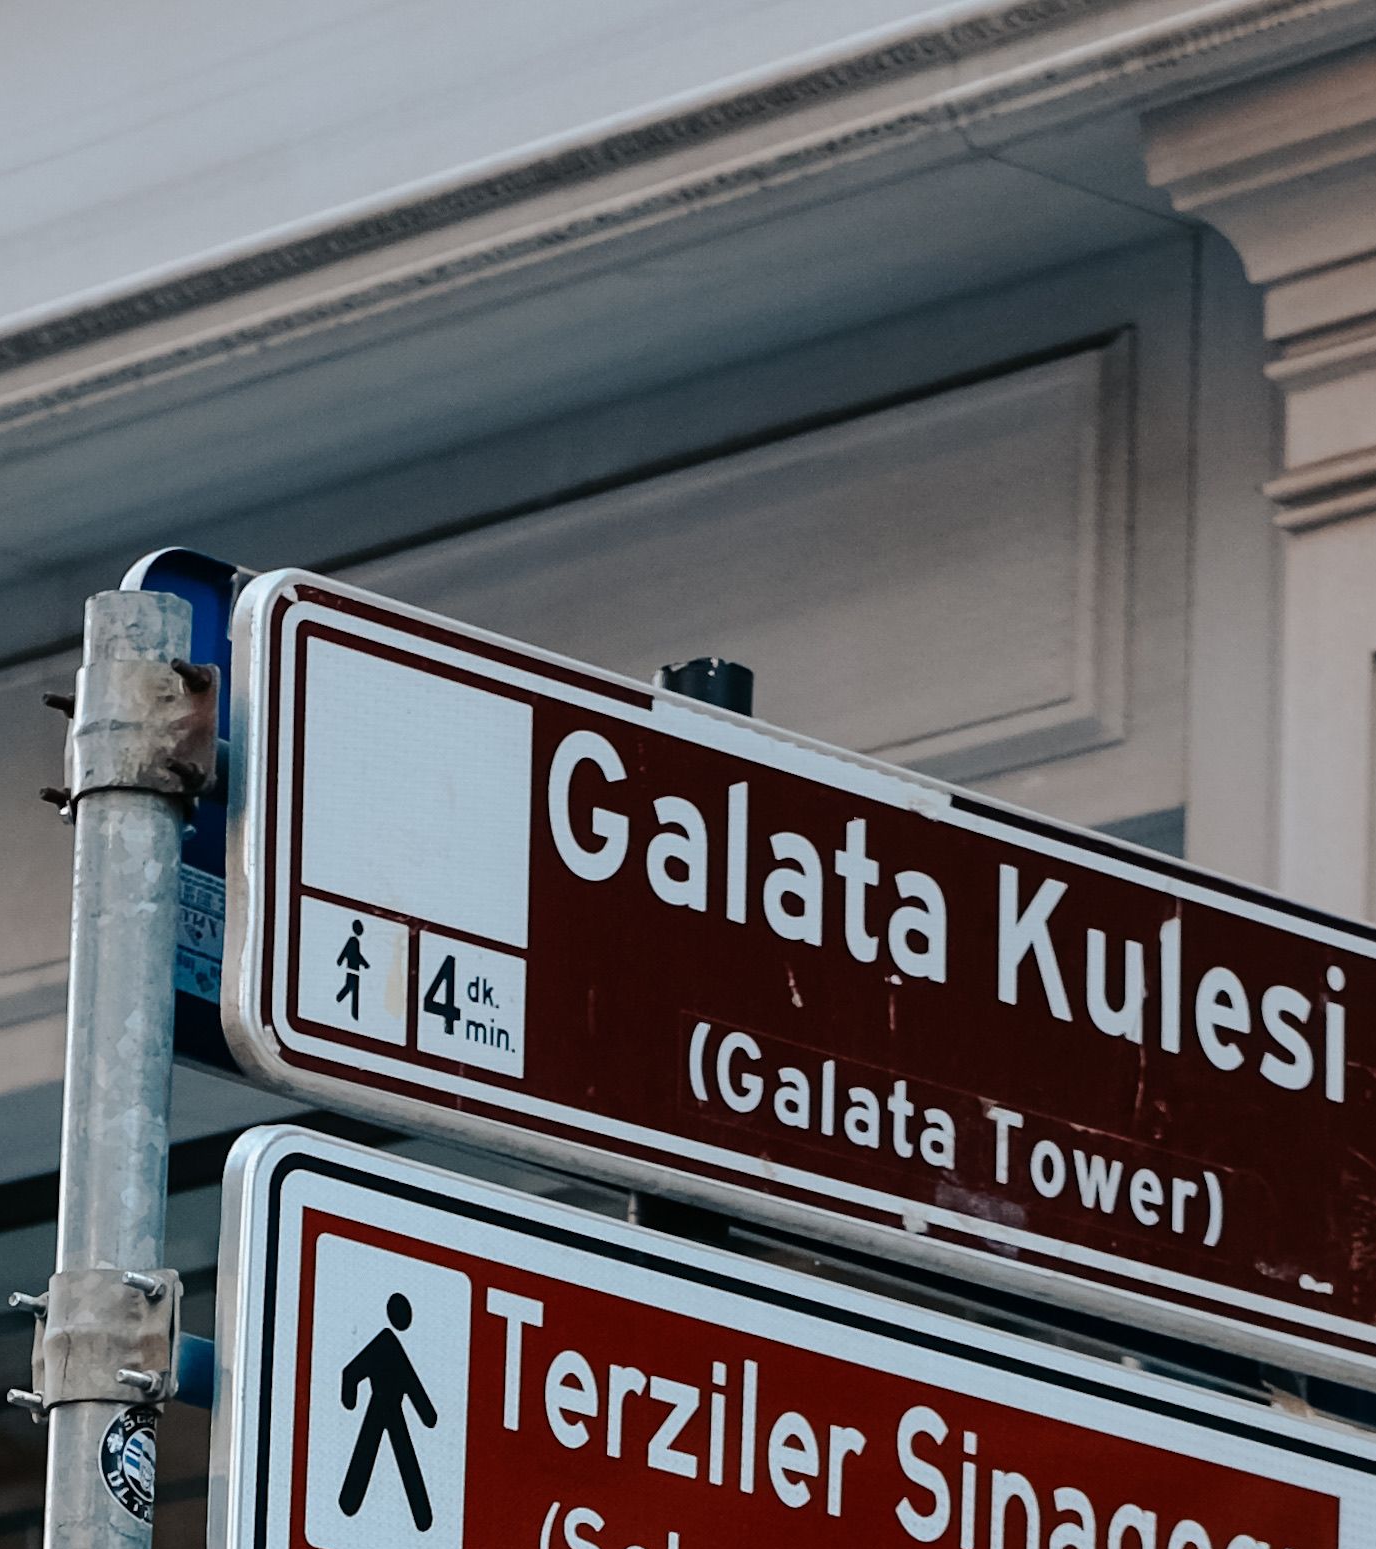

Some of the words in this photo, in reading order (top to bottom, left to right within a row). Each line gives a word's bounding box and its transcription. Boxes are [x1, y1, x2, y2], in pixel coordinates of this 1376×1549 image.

[467, 975, 500, 1009] dk.
[546, 728, 948, 985] Galata
[997, 862, 1347, 1104] Kulesi
[423, 954, 461, 1036] 4
[465, 1018, 516, 1054] min.
[688, 1020, 957, 1171] (Galata
[985, 1104, 1226, 1248] Tower)
[486, 1285, 868, 1518] Terziler
